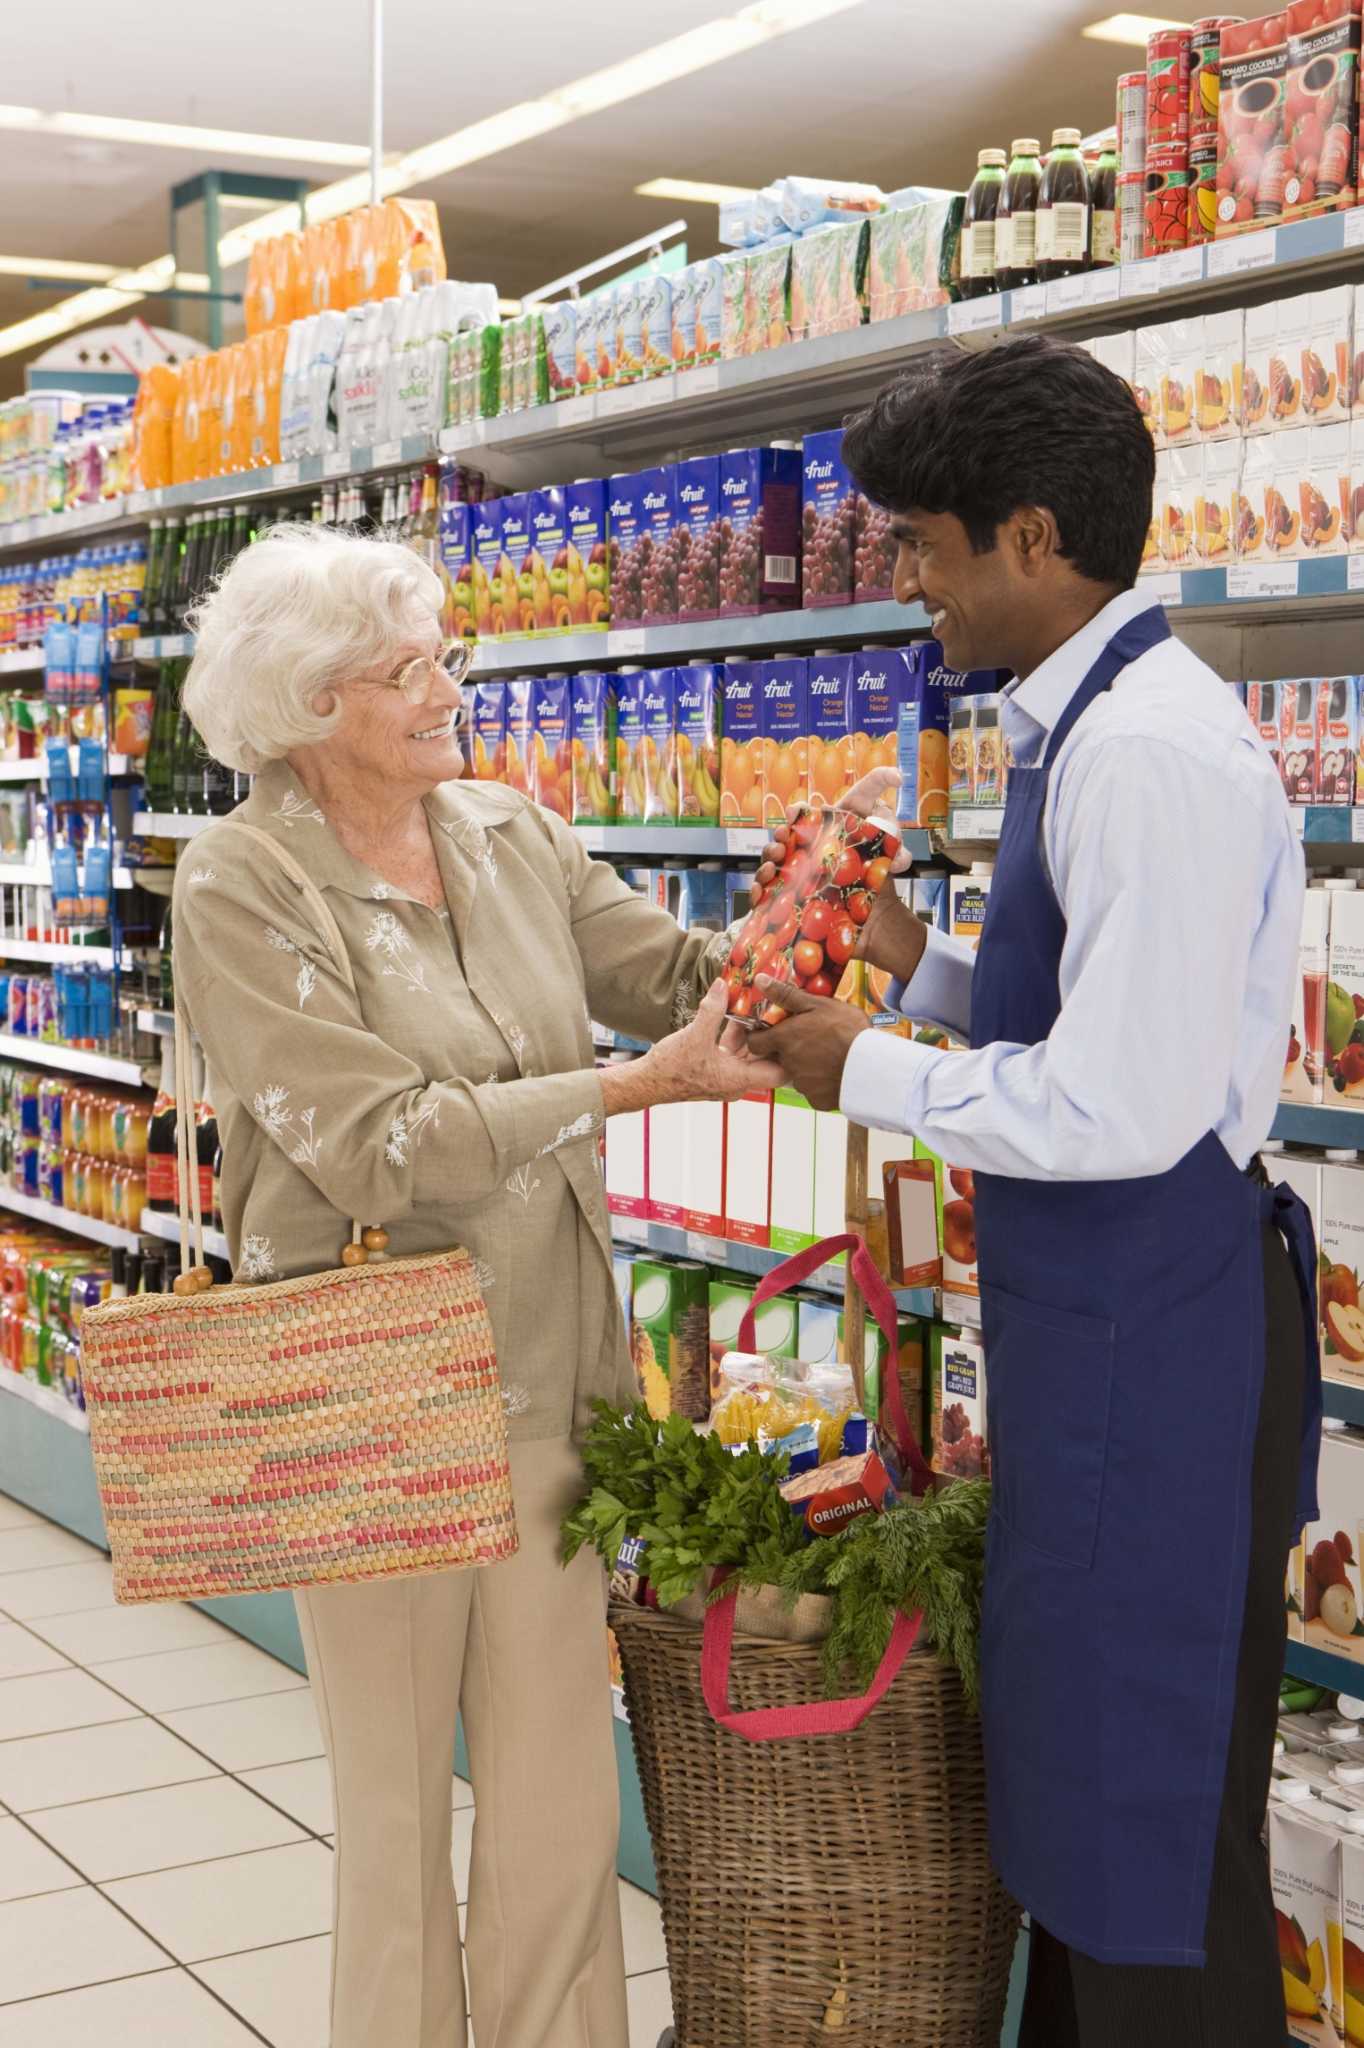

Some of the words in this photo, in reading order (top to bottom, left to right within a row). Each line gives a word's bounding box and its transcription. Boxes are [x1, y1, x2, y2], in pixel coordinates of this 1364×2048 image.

[1222, 66, 1247, 78] TOMATO
[1249, 59, 1277, 71] COCKTAIL
[805, 460, 834, 479] fruit
[680, 485, 705, 503] fruit
[723, 477, 748, 496] fruit
[610, 500, 632, 517] fruit
[643, 492, 667, 510] fruit
[534, 513, 557, 528] fruit
[569, 505, 591, 522] fruit
[811, 674, 841, 695] fruit
[858, 669, 888, 691] fruit
[927, 666, 968, 687] fruit
[726, 680, 753, 699] fruit
[764, 678, 794, 698] fruit
[537, 700, 559, 716] fruit
[574, 697, 594, 714] fruit
[618, 695, 637, 712] fruit
[645, 693, 665, 710] fruit
[679, 690, 701, 708] fruit
[962, 900, 985, 908] ORANGE
[813, 1497, 872, 1524] ORIGINAL
[617, 1538, 642, 1567] uit
